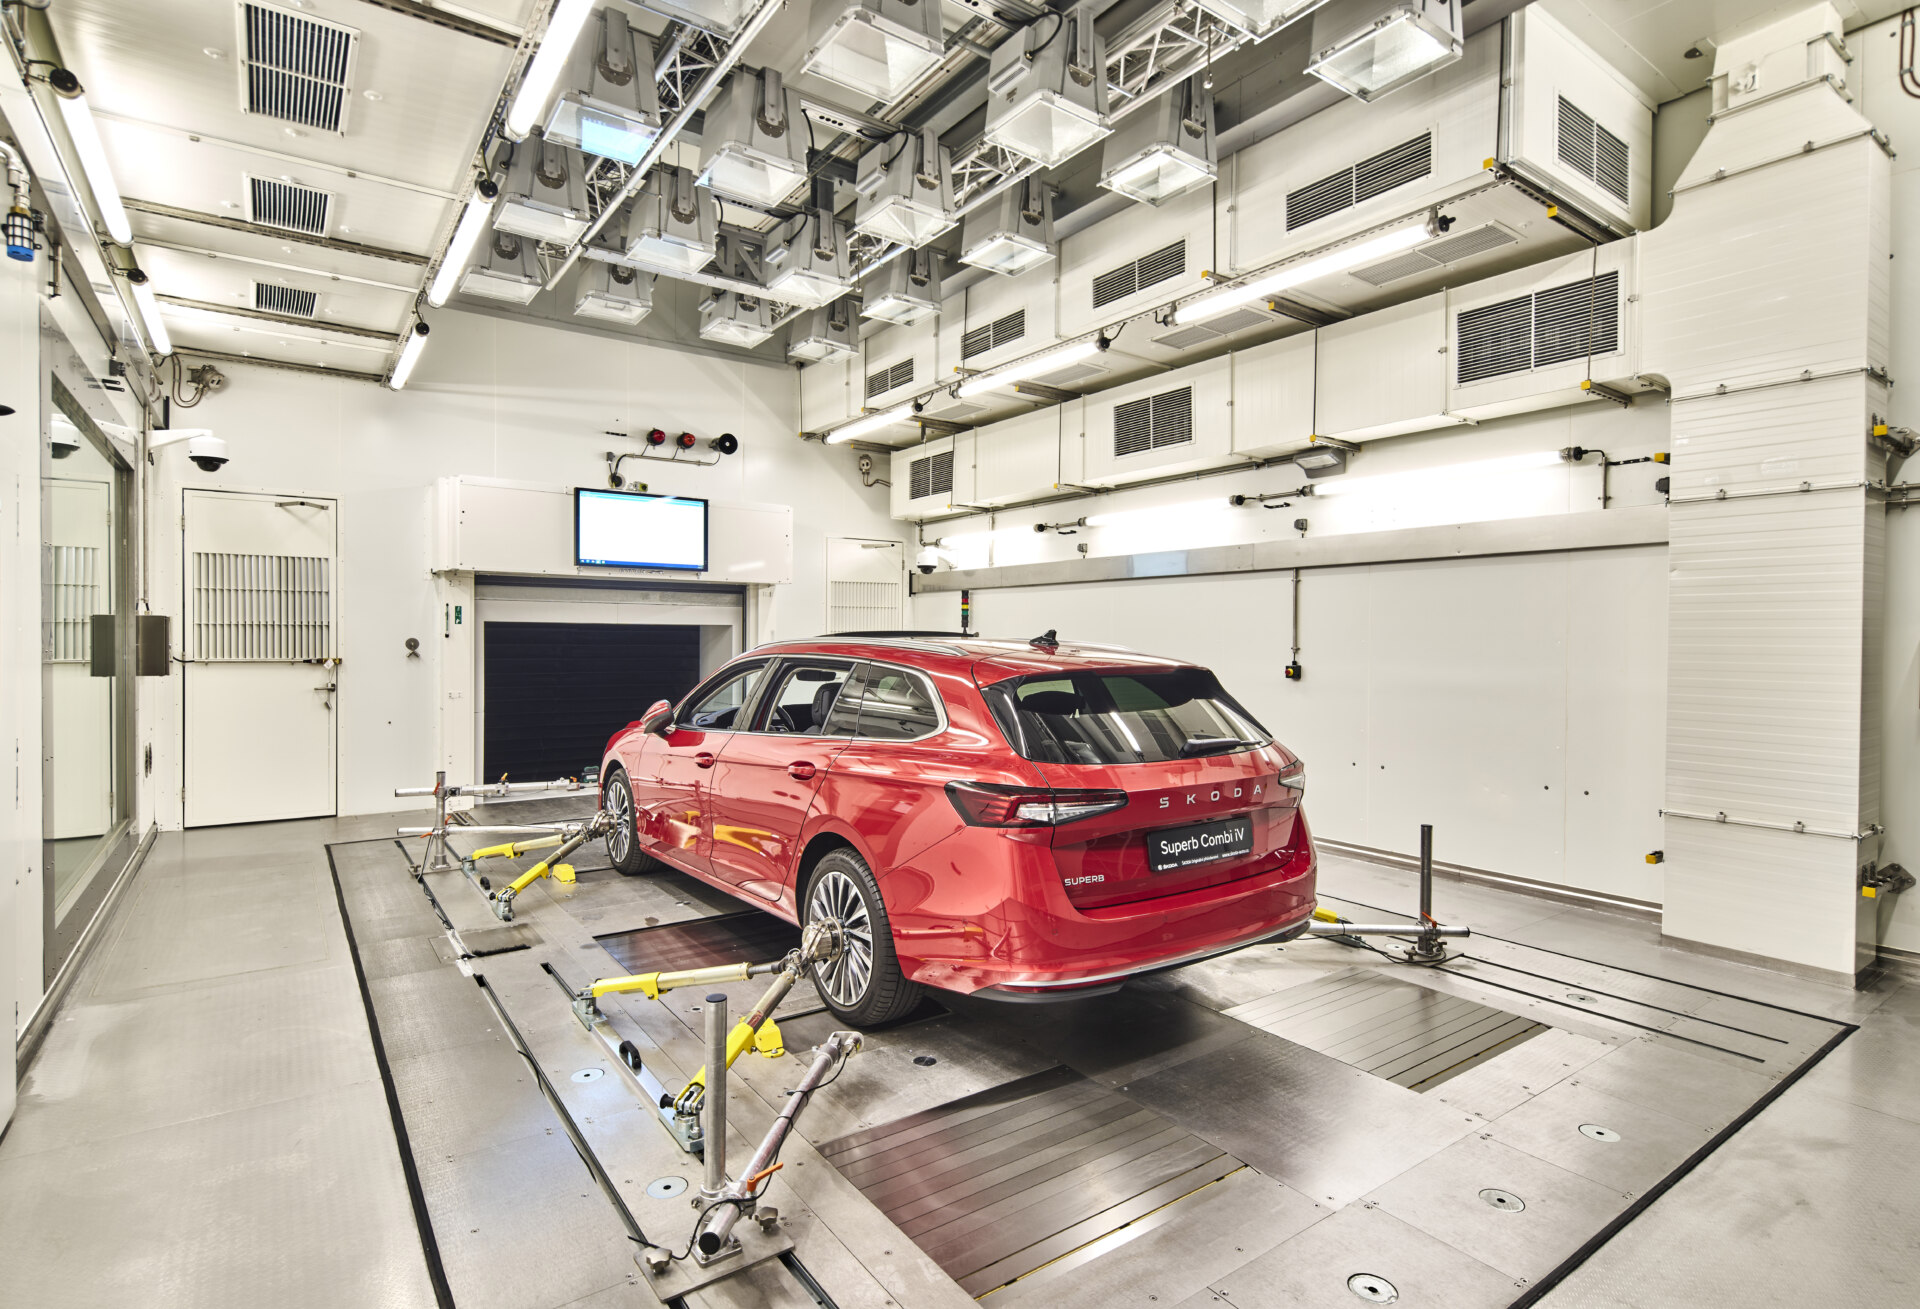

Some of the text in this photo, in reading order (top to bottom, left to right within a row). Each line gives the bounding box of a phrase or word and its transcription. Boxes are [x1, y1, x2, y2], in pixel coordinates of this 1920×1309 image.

[1160, 827, 1245, 857] Superb Combi iV
[1064, 874, 1105, 886] SUPERB
